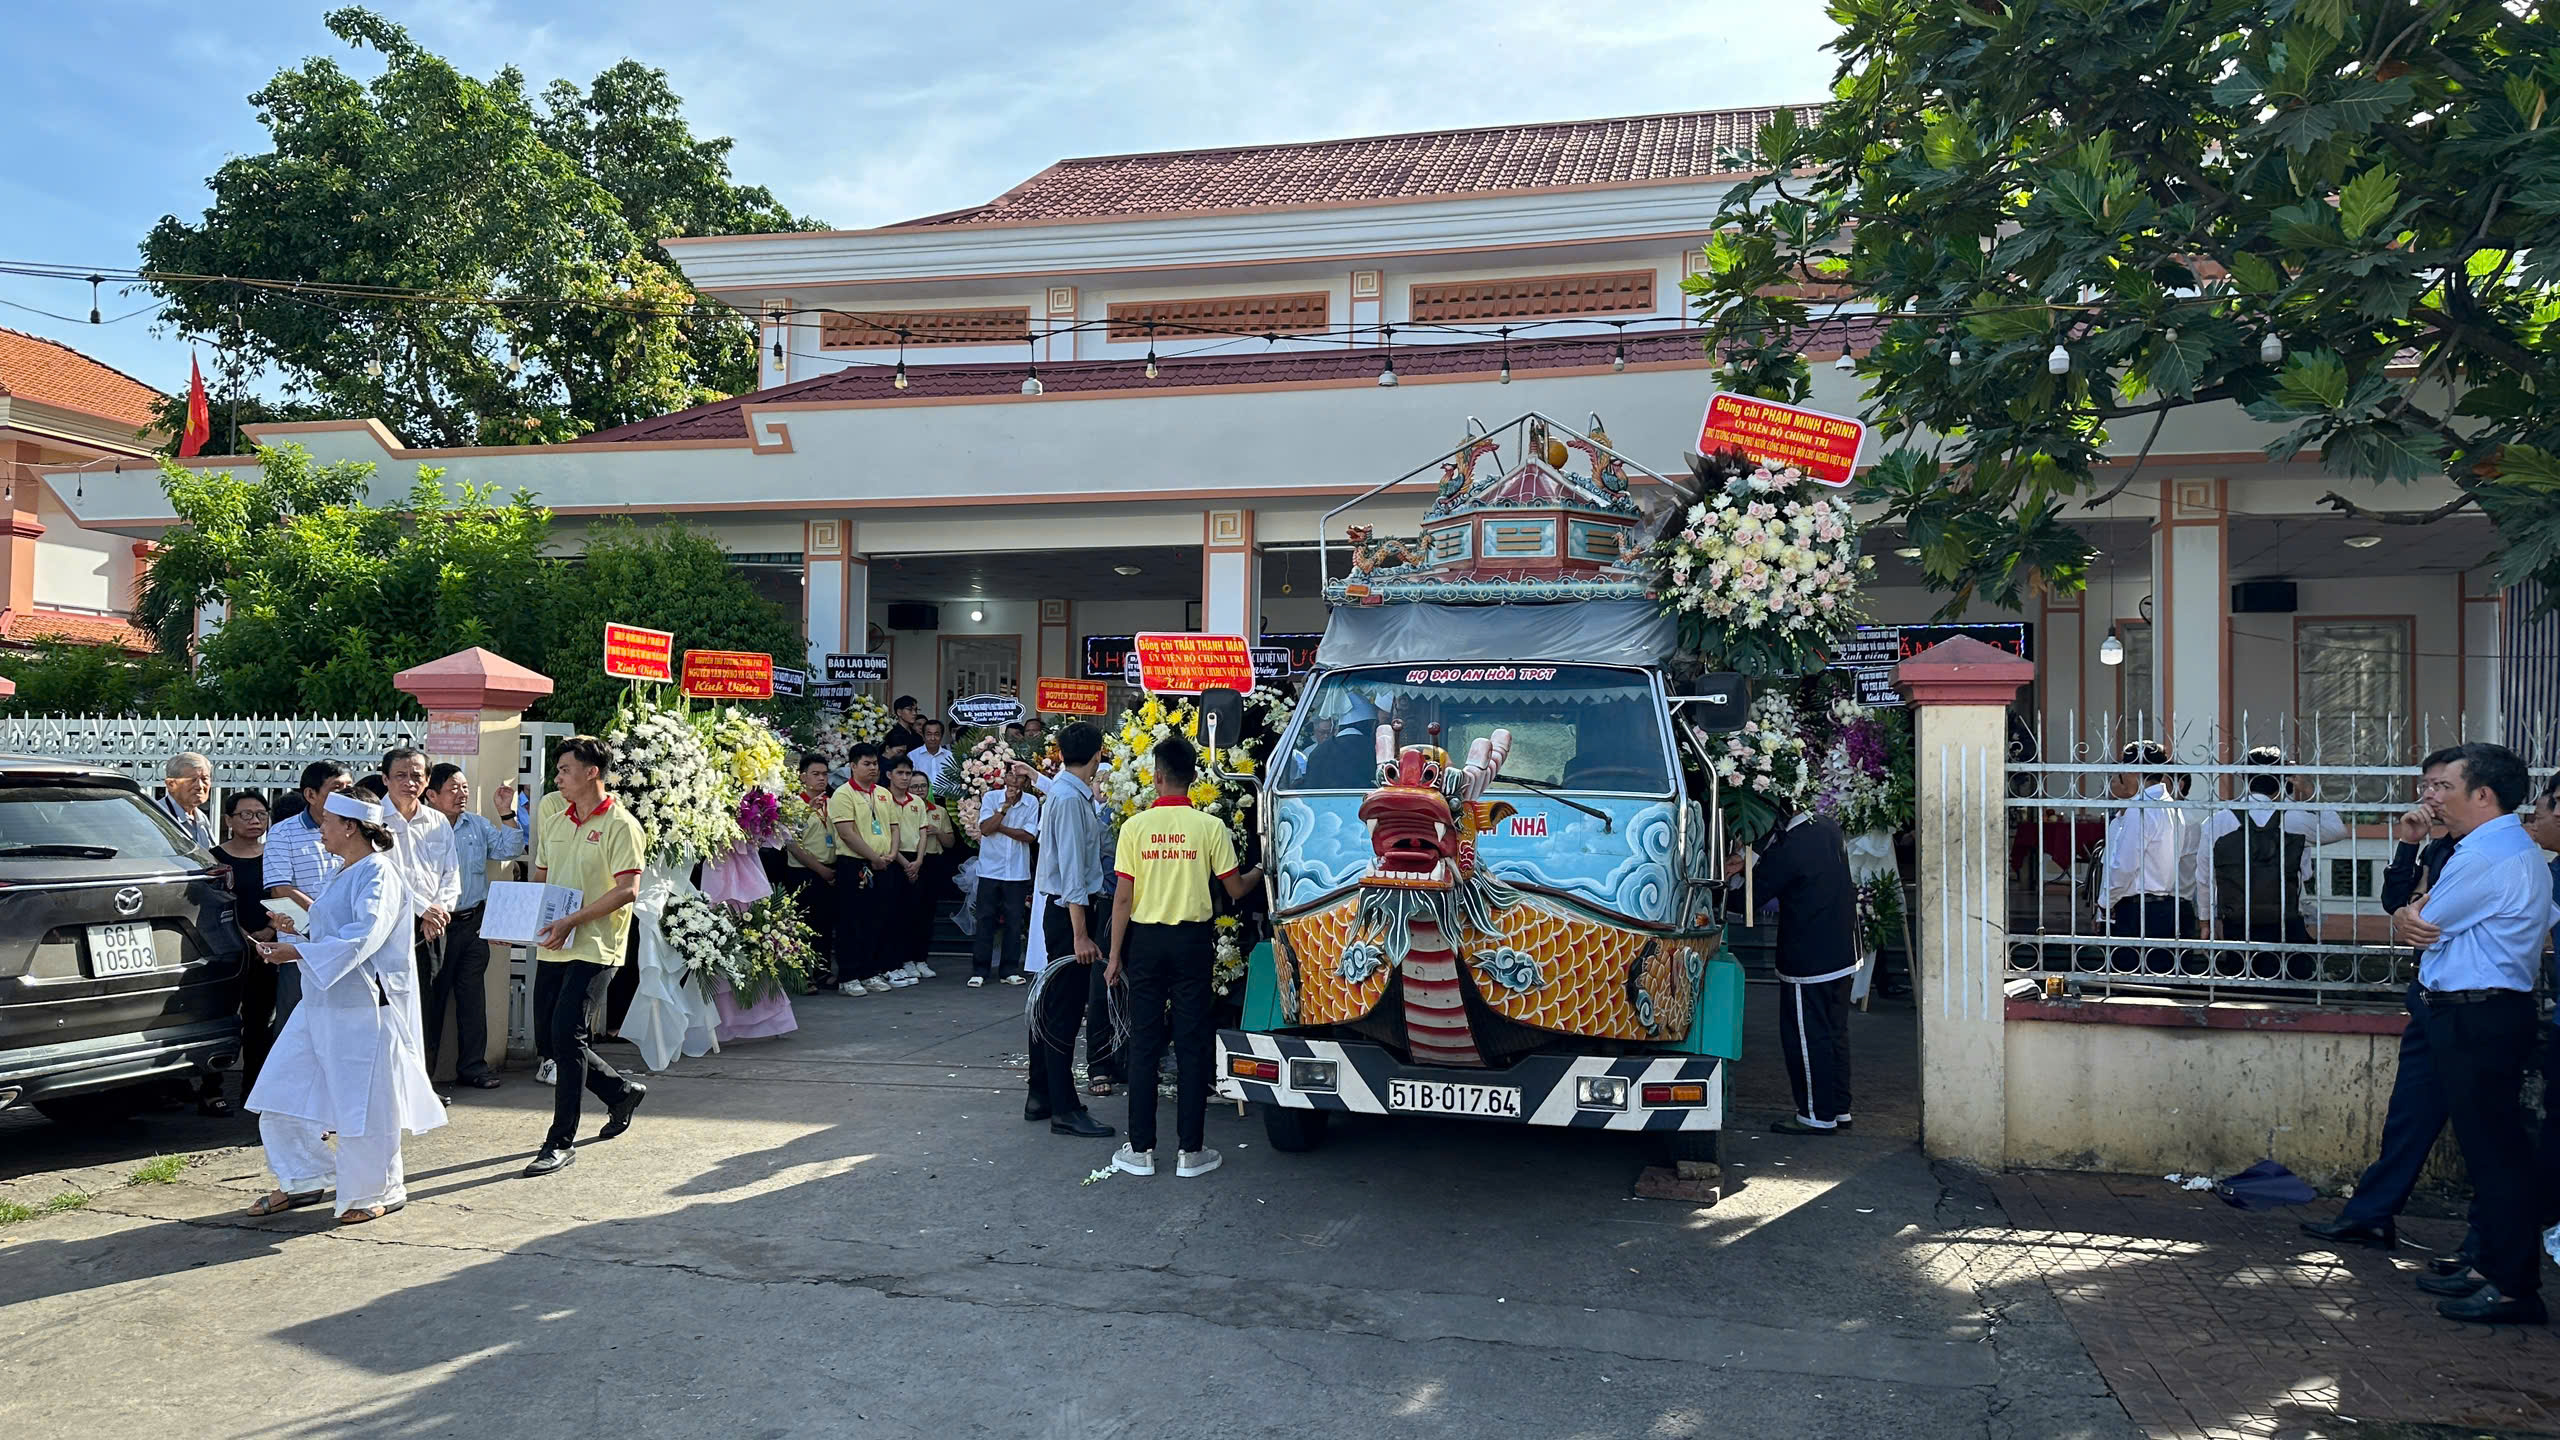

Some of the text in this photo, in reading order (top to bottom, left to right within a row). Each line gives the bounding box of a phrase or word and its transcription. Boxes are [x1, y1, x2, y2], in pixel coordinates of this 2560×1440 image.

[1716, 398, 1858, 439] Đồng chí PHẠM MINH CHÍNH
[1748, 422, 1769, 435] VIÊN
[1770, 426, 1783, 439] BỘ
[1784, 429, 1813, 444] CHÍNH
[1815, 437, 1830, 450] TRỊ
[1139, 639, 1160, 653] Đồng
[1161, 640, 1172, 651] chí
[1173, 636, 1195, 651] TRẦN
[1197, 640, 1224, 651] THANH
[828, 656, 887, 670] BÁO LAO ĐỘNG
[1161, 652, 1182, 662] VIÊN
[1184, 653, 1196, 664] BỘ
[1198, 652, 1226, 663] CHÍNH
[1228, 655, 1246, 666] TRỊ
[1276, 653, 1287, 662] NAM
[1840, 652, 1890, 660] Kính viếng
[616, 661, 636, 674] Kính
[835, 670, 881, 680] Kính Viếng
[1406, 666, 1556, 684] HỌ ĐẠO AN HÒA TPCT
[695, 680, 760, 694] Kính Viếng
[1163, 677, 1194, 688] Kính
[1047, 701, 1069, 709] Kính
[1511, 812, 1547, 837] NHÃ
[1151, 834, 1186, 845] ĐẠI HỌC
[1141, 846, 1197, 860] NAM CẦN THƠ
[104, 925, 138, 947] 66A
[96, 947, 153, 972] 105.03
[1392, 1083, 1516, 1115] 51B-017.64
